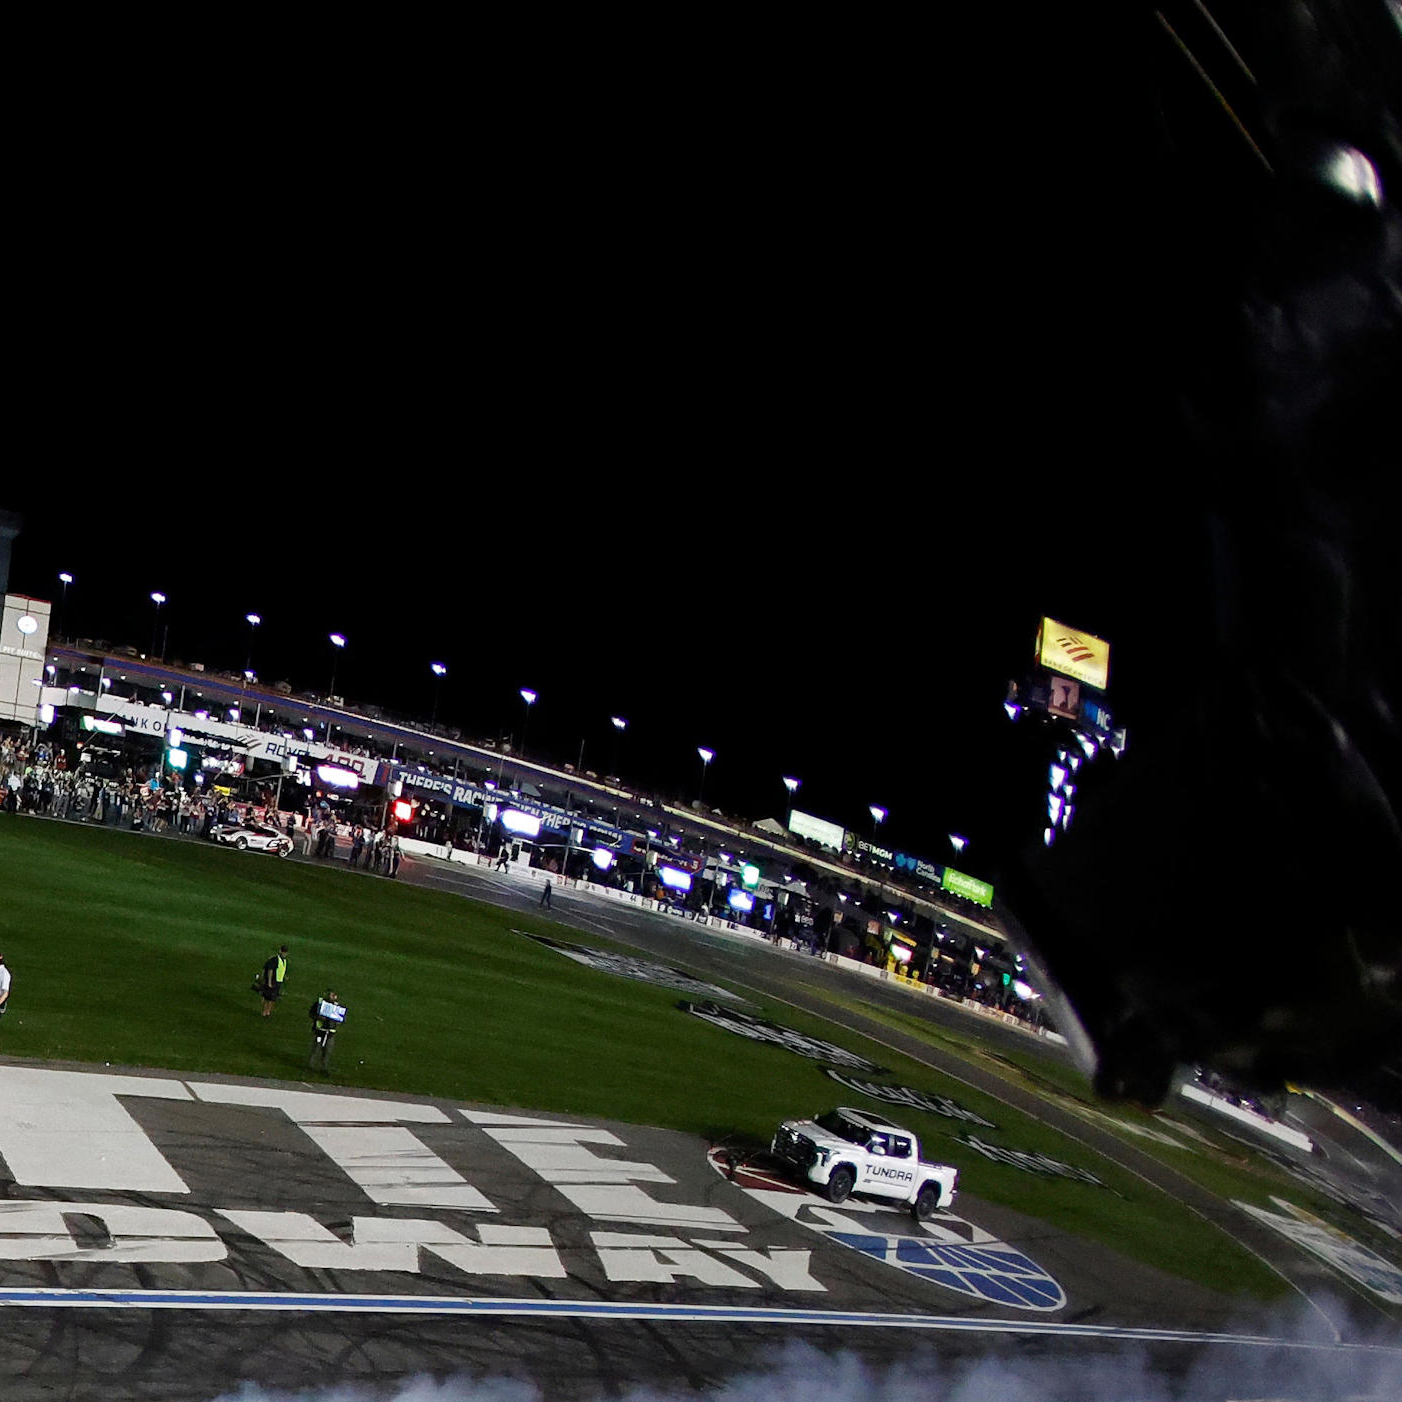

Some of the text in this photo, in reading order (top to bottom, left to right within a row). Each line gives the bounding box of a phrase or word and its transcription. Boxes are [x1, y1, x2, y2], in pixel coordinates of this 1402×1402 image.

[1096, 708, 1112, 731] NC
[858, 840, 893, 861] BETMGM
[917, 859, 935, 873] North
[864, 1163, 914, 1182] TUNDRA
